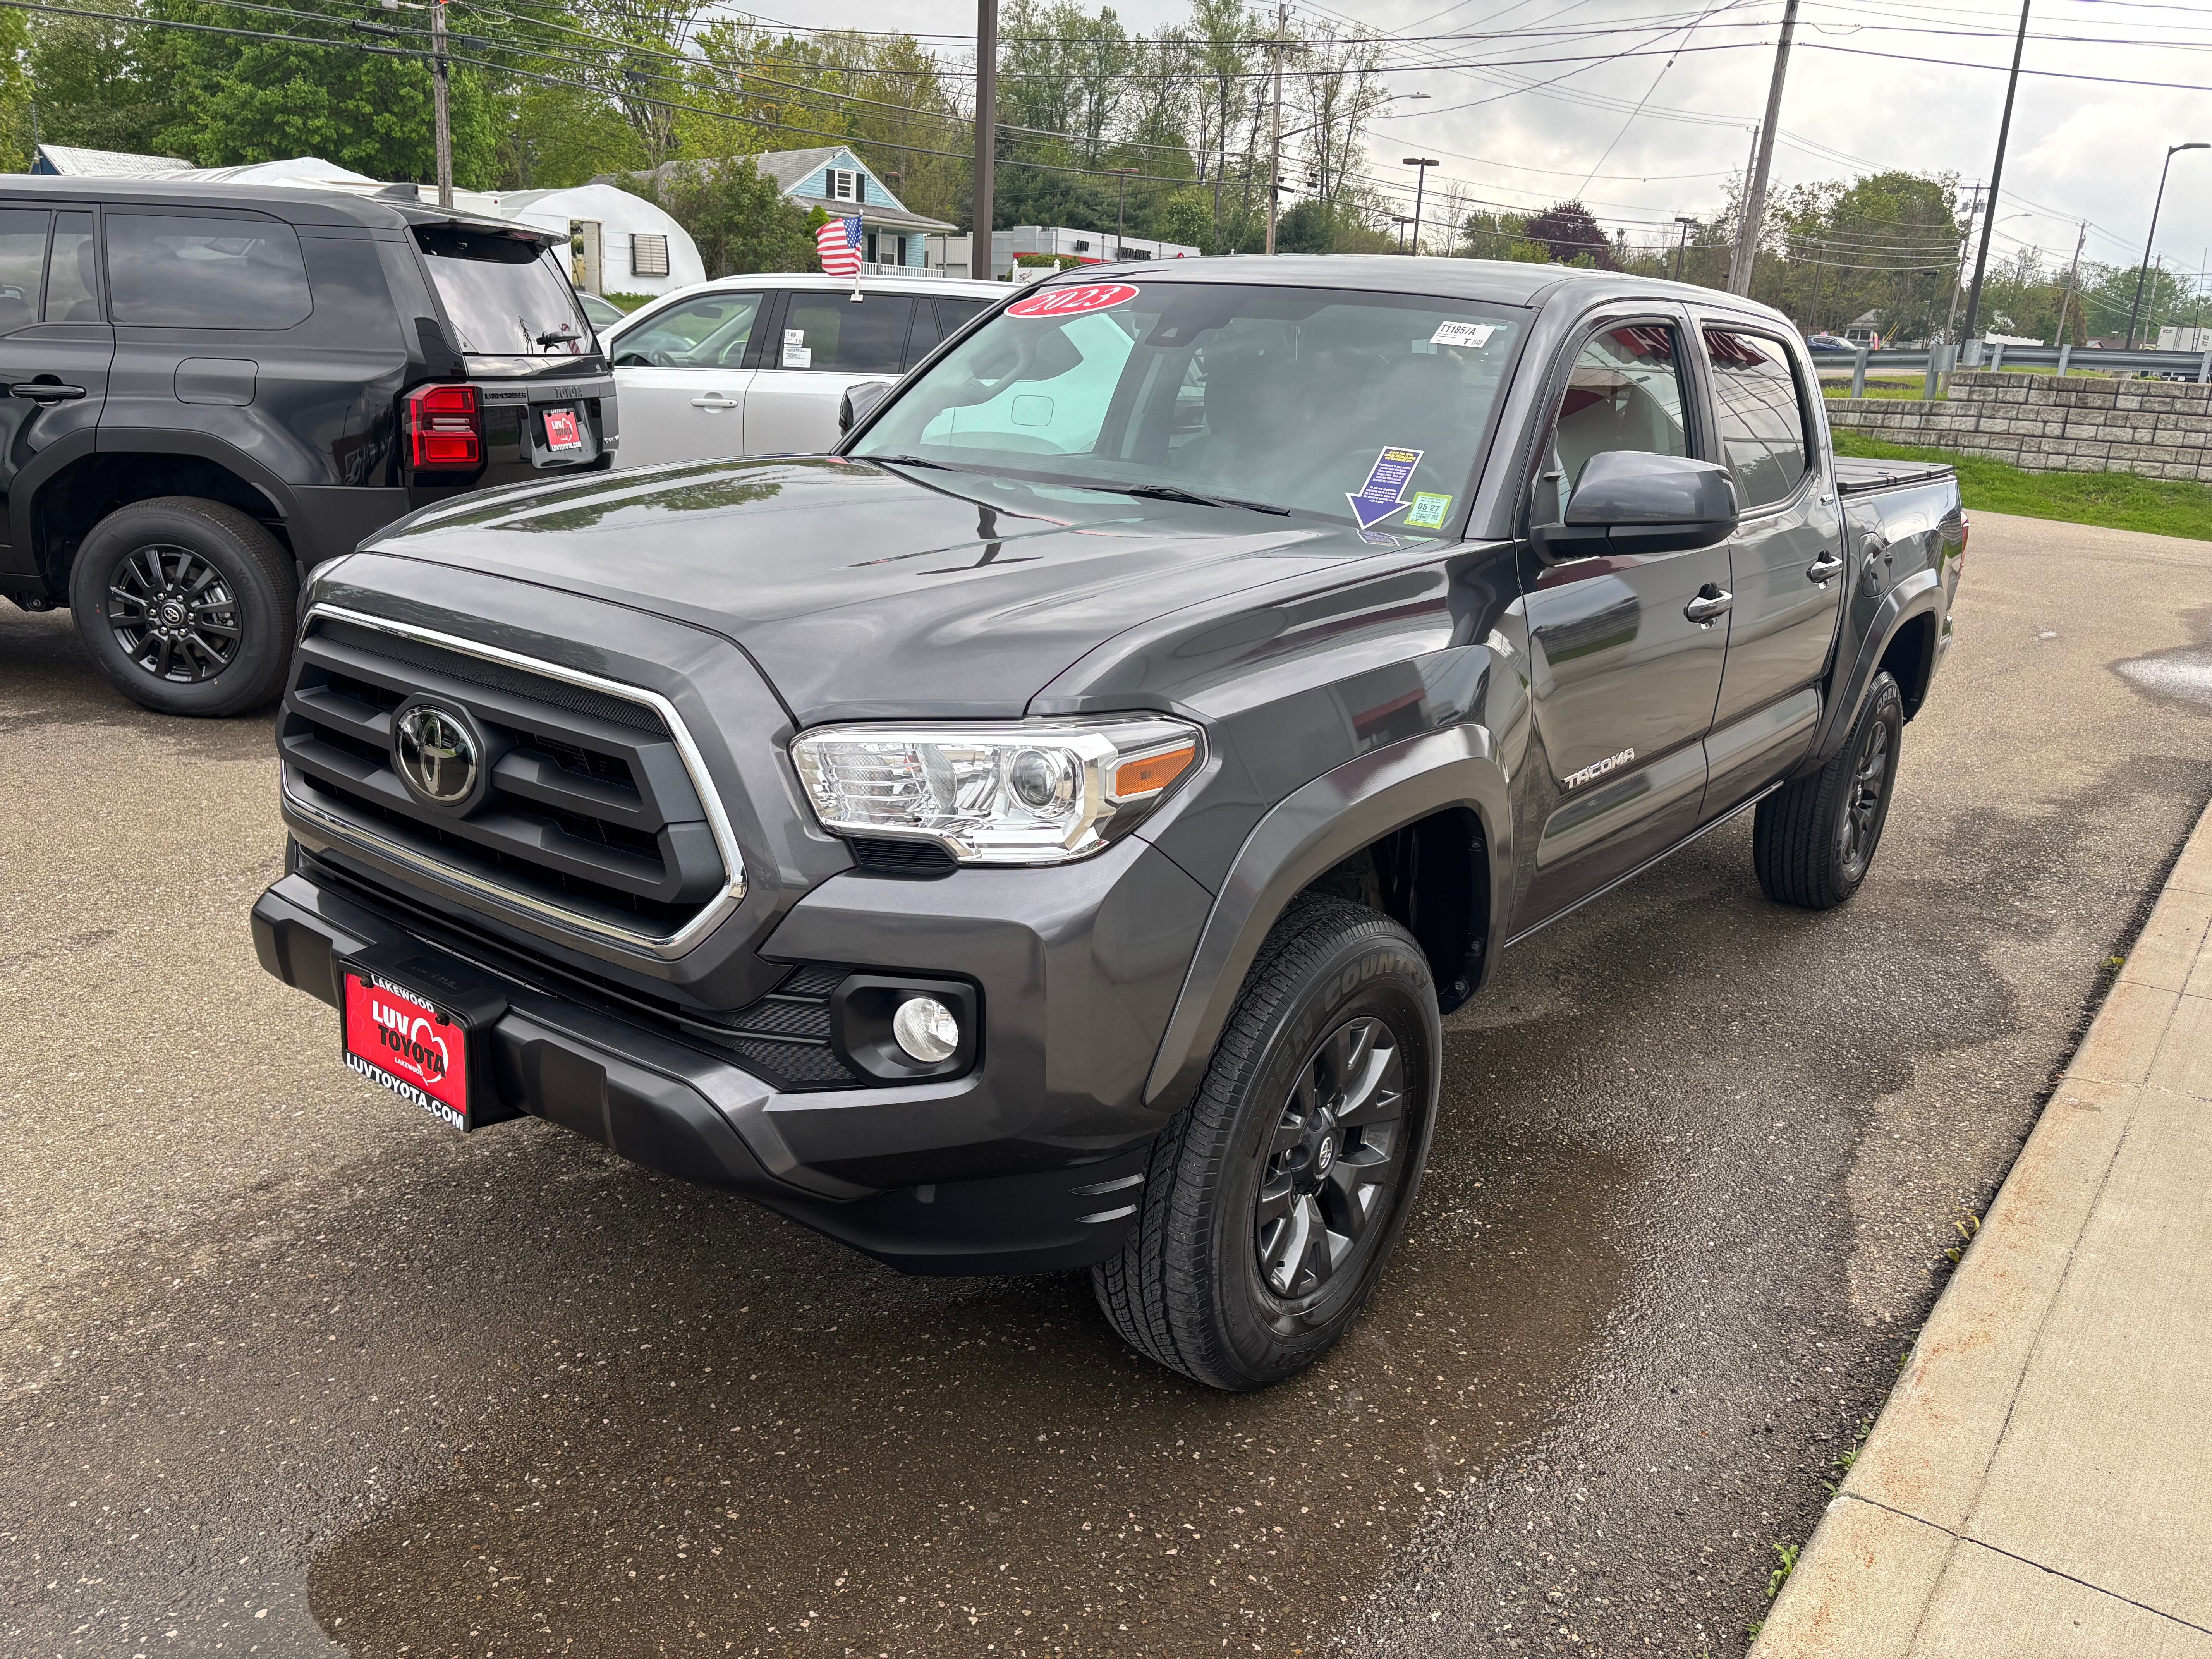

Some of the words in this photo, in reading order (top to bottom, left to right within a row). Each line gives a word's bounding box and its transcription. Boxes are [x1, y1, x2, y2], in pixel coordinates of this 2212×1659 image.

[1019, 286, 1121, 313] 2023
[1440, 325, 1476, 335] T11857A
[555, 387, 582, 400] TOYOTA
[551, 421, 562, 429] LUV
[556, 428, 573, 437] TOYOTA
[551, 441, 582, 452] LUVTOYOTA.COM
[1877, 687, 1896, 714] OPEN
[1561, 747, 1635, 790] TACOMA
[371, 974, 435, 1013] LAKEWOOD
[1324, 952, 1430, 1012] COUNTRY
[372, 1000, 409, 1035] LUV
[378, 1024, 446, 1078] TOYOTA
[394, 1056, 424, 1077] LAKEWOOD
[346, 1052, 464, 1131] LUVTOYOTA.COM
